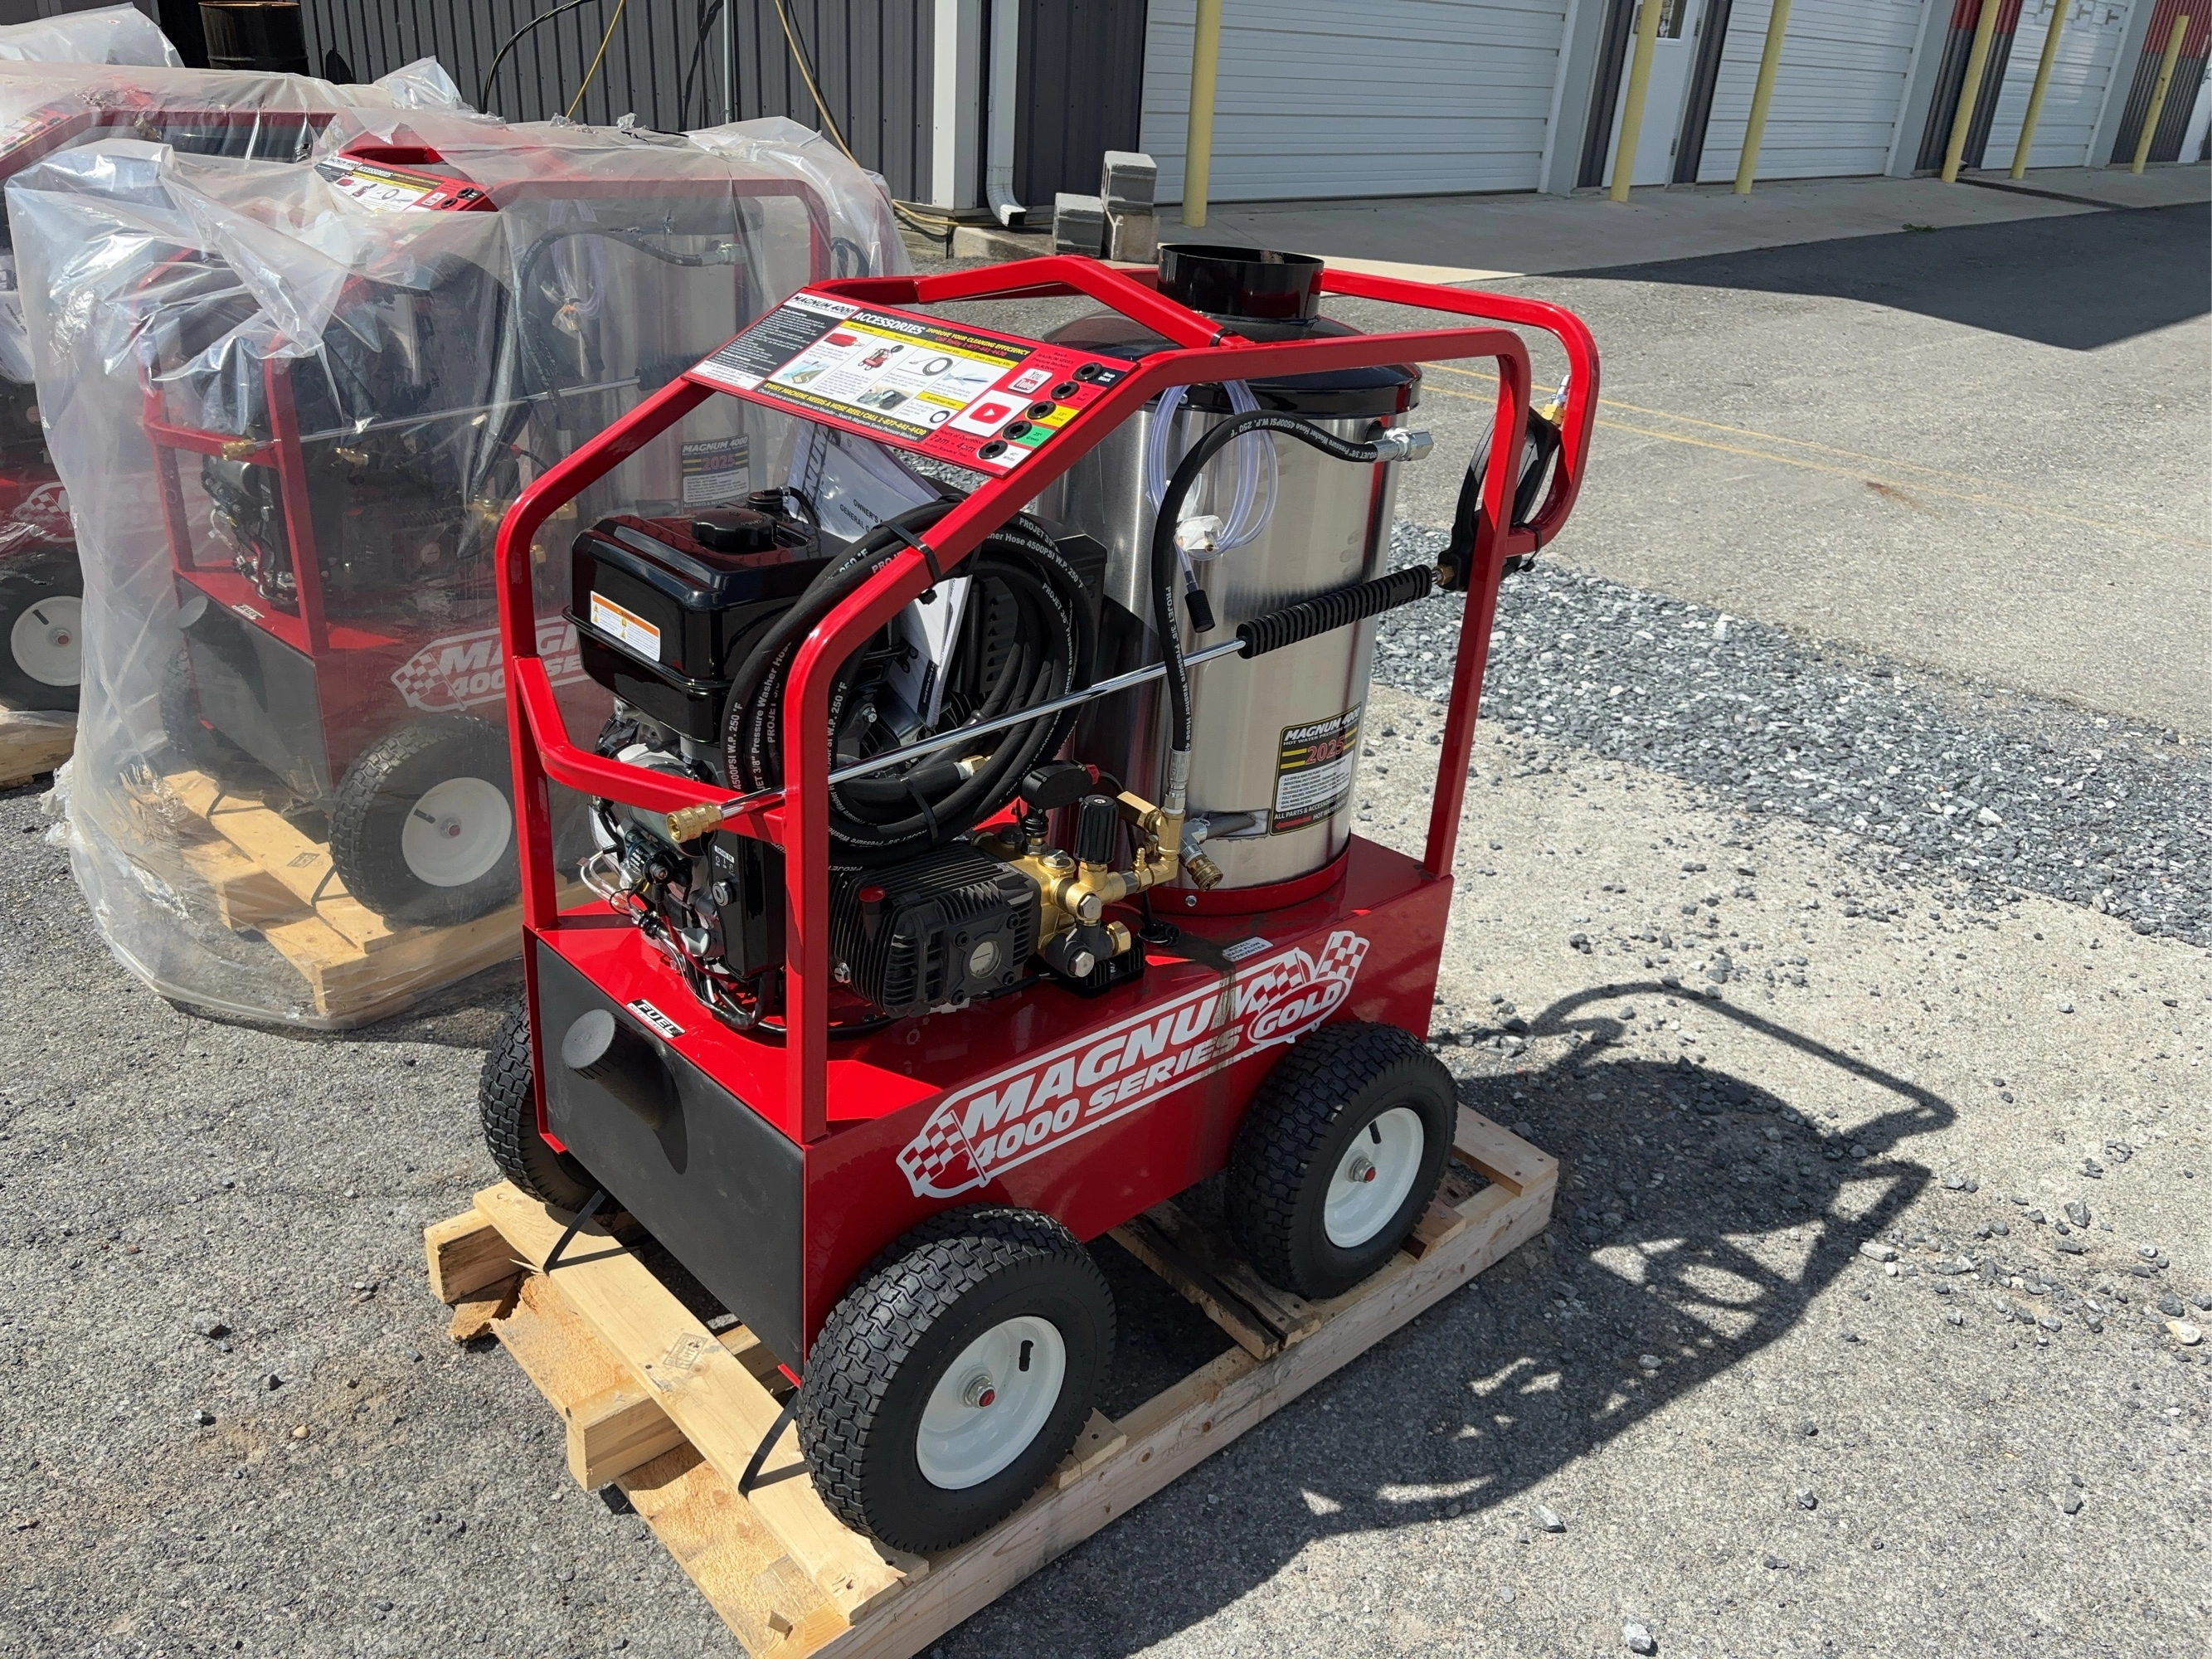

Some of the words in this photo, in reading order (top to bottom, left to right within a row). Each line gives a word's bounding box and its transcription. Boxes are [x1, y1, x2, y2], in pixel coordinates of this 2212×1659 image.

[790, 295, 834, 309] MAGNUM
[829, 304, 856, 314] 4000
[849, 311, 928, 335] ACCESSORIES
[924, 327, 953, 337] IMPROVE
[949, 333, 970, 341] YOUR
[964, 337, 997, 348] CLEANING
[992, 343, 1031, 356] EFFICIENCY
[943, 338, 965, 346] Today
[1014, 378, 1038, 390] Tube
[1026, 370, 1047, 380] You
[762, 382, 785, 392] EVERY
[780, 387, 810, 399] MACHINE
[805, 395, 829, 405] NEEDS
[828, 402, 849, 411] HOSE
[843, 407, 866, 416] REEL!
[860, 412, 881, 421] CALL
[875, 416, 928, 435] 1-877-441-4430
[780, 396, 802, 405] accessory
[815, 406, 837, 415] Youtube
[848, 416, 873, 426] Magnum
[880, 426, 902, 435] Pressure
[897, 431, 921, 440] Washers
[1239, 421, 1252, 432] 250
[1254, 417, 1268, 426] W.P.
[1270, 418, 1296, 429] 4500PSI
[1296, 423, 1310, 435] Hose
[683, 441, 729, 453] MAGNUM
[730, 436, 748, 447] 4000
[927, 434, 953, 445] 7am
[951, 441, 979, 455] 4pm
[957, 435, 984, 445] Operation
[1310, 431, 1328, 445] Washer
[1329, 440, 1349, 455] Pressure
[702, 453, 736, 472] 2025
[1360, 450, 1378, 459] ROJET
[840, 504, 864, 529] GENERAL
[853, 499, 878, 523] OWNER'S
[1018, 517, 1044, 538] PROJET
[1005, 533, 1025, 546] Hose
[1026, 539, 1055, 560] 4500PSI
[1056, 555, 1068, 572] W.P.
[1068, 567, 1079, 582] 250
[1042, 582, 1062, 612] PROJET
[1165, 586, 1175, 624] PROJET
[1174, 643, 1186, 683] Pressure
[1182, 682, 1191, 716] Washer
[448, 671, 505, 697] 400
[757, 669, 777, 704] Washer
[831, 695, 843, 714] 250
[729, 714, 741, 732] 250
[751, 711, 764, 753] Pressure
[828, 718, 837, 735] W.P.
[1284, 718, 1342, 742] MAGNUM
[1342, 706, 1361, 726] 4000
[1319, 727, 1344, 739] PRESSURE
[727, 733, 737, 754] W.P.
[1305, 734, 1346, 766] 2025
[727, 755, 741, 790] 4500PSI
[1286, 808, 1303, 818] PARTS
[1308, 796, 1336, 813] ACCESSORIES
[1313, 812, 1323, 820] HOT
[1323, 806, 1337, 818] WATER
[849, 837, 884, 847] Pressure
[637, 1003, 674, 1034] FUEL
[1253, 984, 1343, 1039] GOLD
[960, 972, 1277, 1139] MAGNUM
[966, 1097, 1081, 1170] 4000
[1085, 1025, 1241, 1117] SERIES
